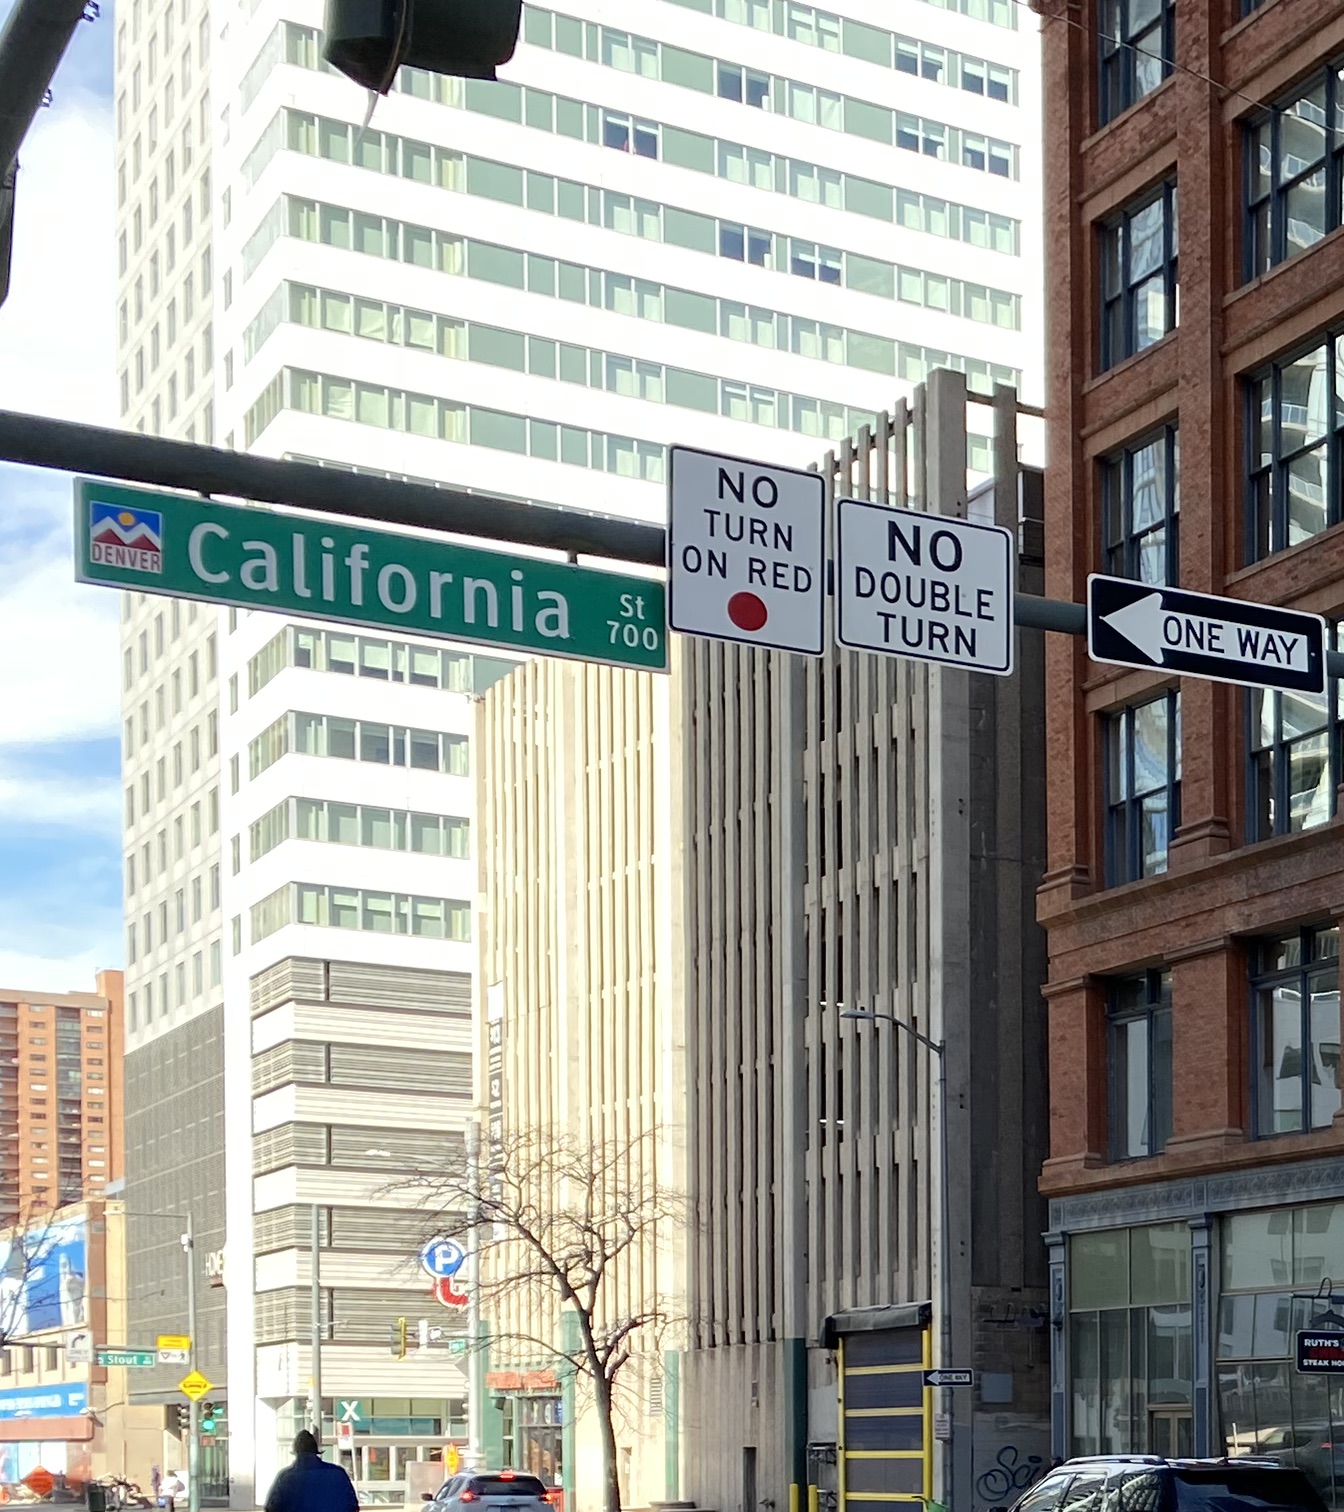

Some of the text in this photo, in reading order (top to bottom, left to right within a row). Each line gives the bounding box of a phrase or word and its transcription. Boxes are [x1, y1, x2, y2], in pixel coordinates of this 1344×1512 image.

[718, 467, 779, 509] NO
[703, 508, 793, 552] TURN
[887, 520, 963, 573] NO
[92, 544, 162, 574] DENVER
[187, 521, 571, 639] California
[682, 544, 812, 593] ON RED
[619, 592, 646, 621] St
[855, 566, 995, 622] DOUBLE
[607, 618, 659, 652] 700
[877, 611, 977, 658] TURN
[1163, 615, 1299, 665] ONE WAY
[108, 1354, 138, 1365] Stout
[1304, 1338, 1340, 1347] RUTH'S
